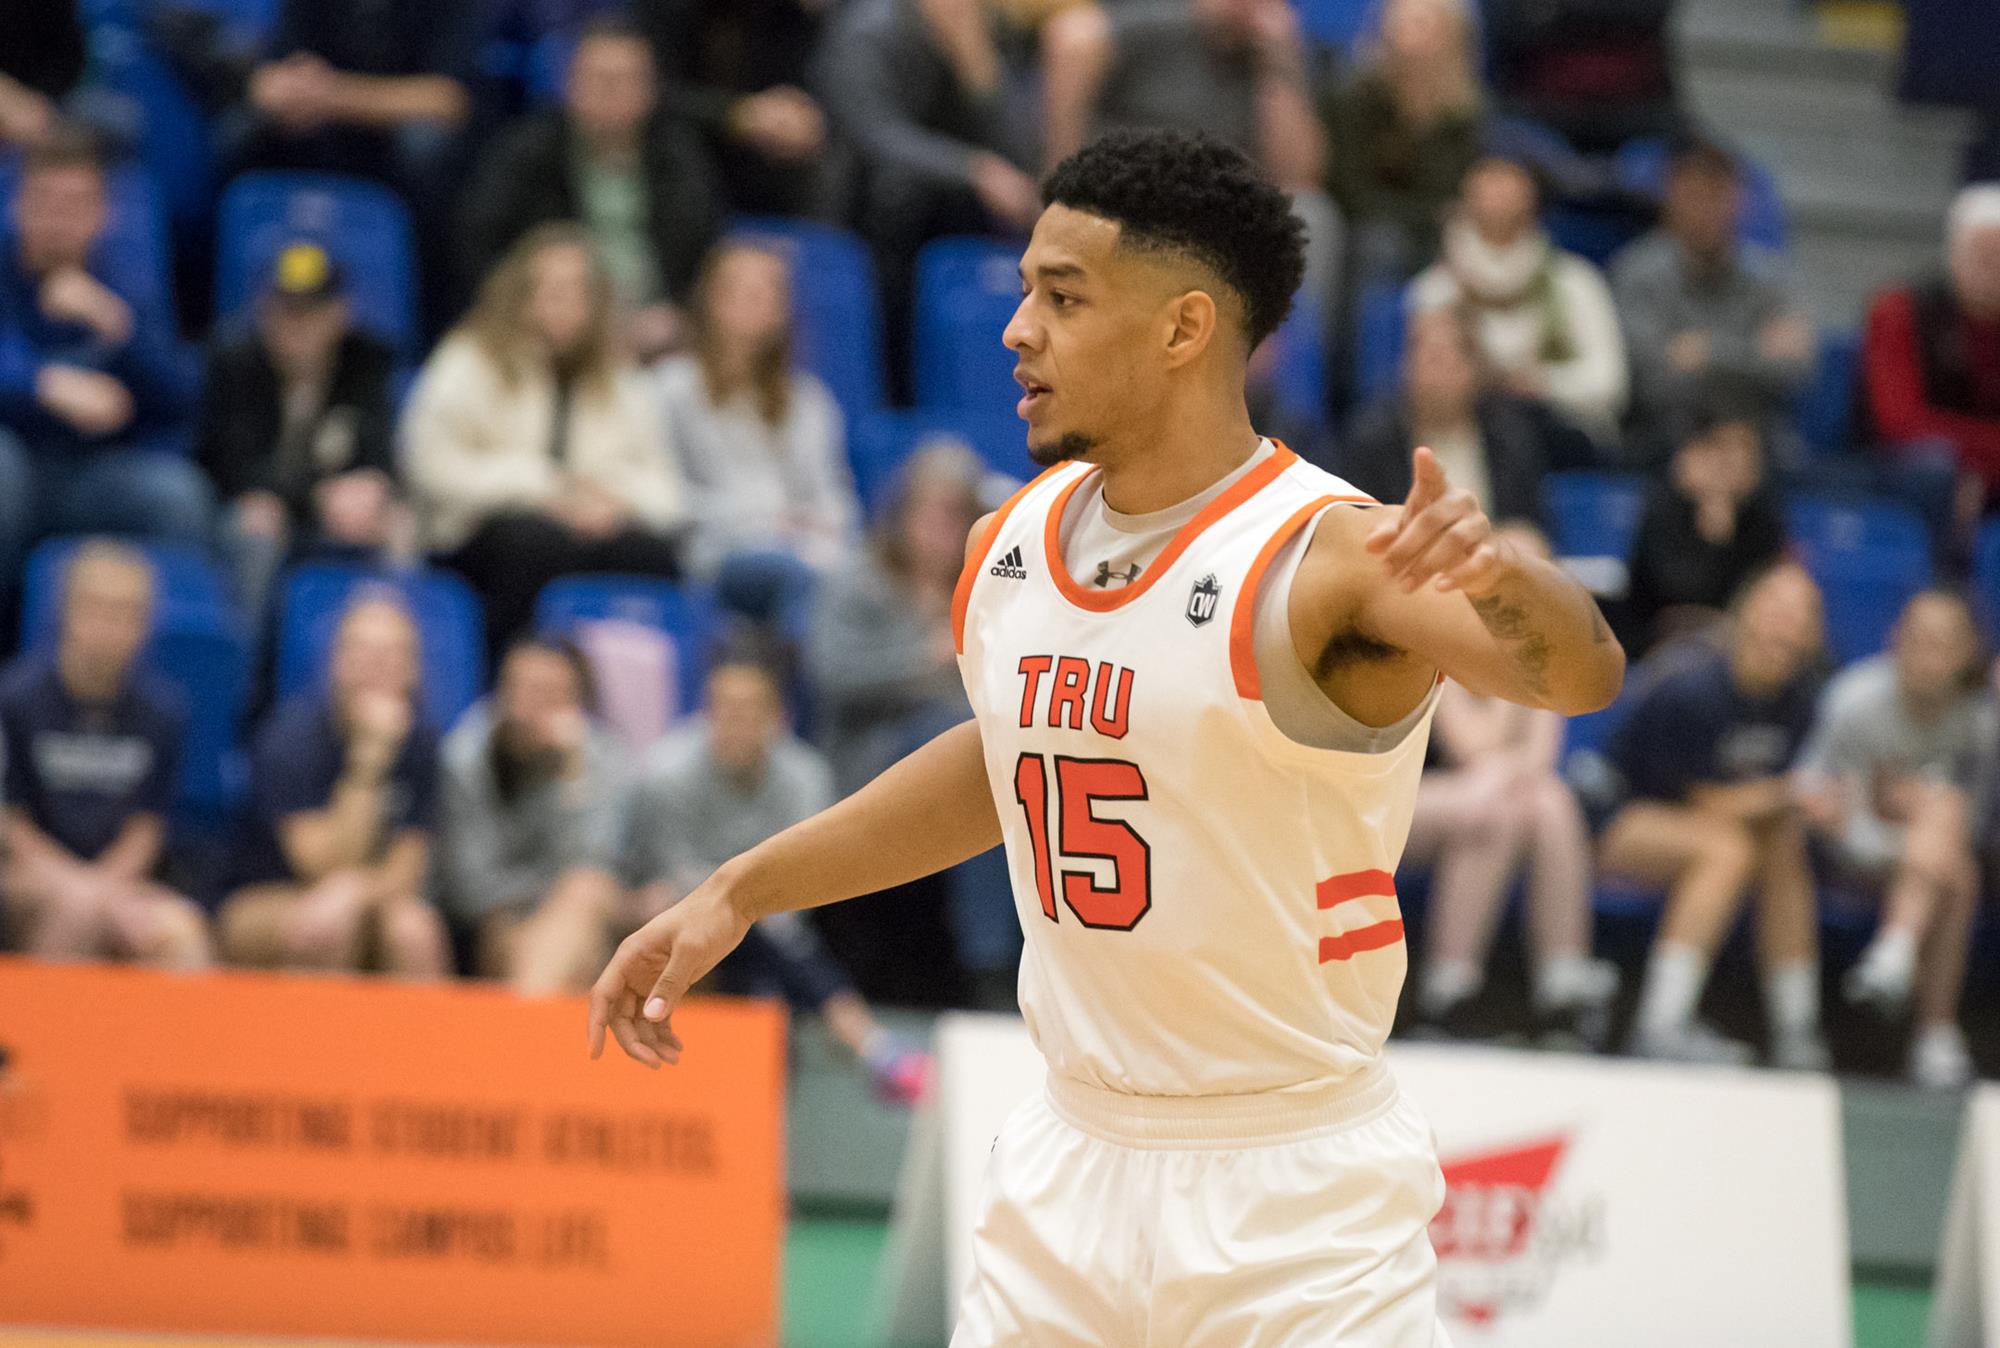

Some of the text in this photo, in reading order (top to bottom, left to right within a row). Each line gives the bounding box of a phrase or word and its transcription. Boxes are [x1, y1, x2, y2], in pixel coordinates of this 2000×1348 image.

[990, 565, 1027, 580] adidas
[1189, 592, 1217, 619] CW
[1018, 655, 1135, 740] TRU
[1014, 752, 1152, 932] 15
